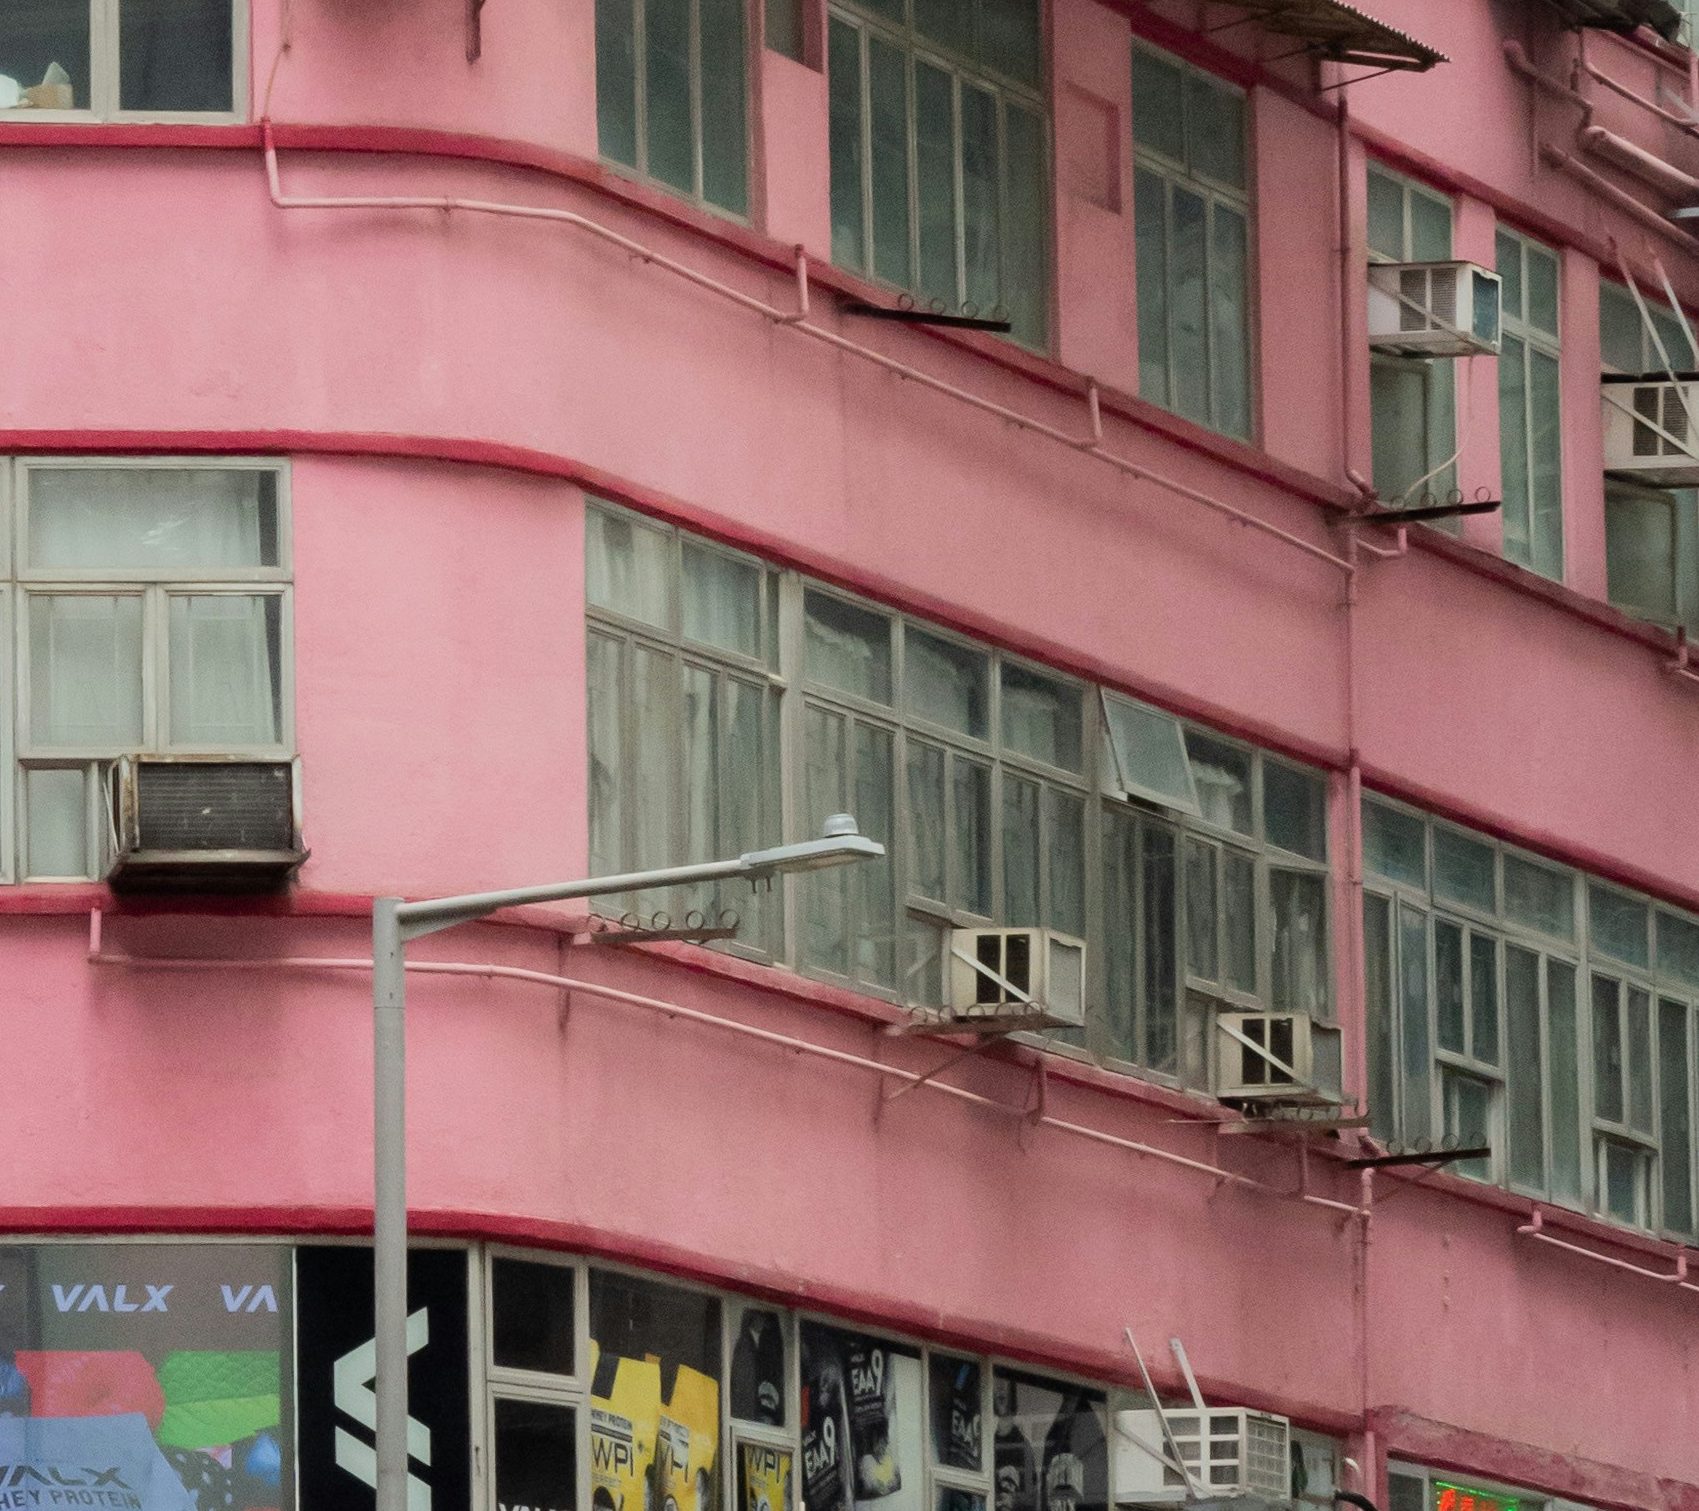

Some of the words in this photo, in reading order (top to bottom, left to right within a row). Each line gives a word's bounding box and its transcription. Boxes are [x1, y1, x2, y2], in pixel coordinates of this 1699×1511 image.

[51, 1284, 174, 1313] VALX
[220, 1285, 279, 1313] VA
[851, 1348, 885, 1396] EAA9
[591, 1435, 633, 1477] WPI
[803, 1415, 835, 1481] EAA9
[50, 1489, 142, 1511] PROTEIN
